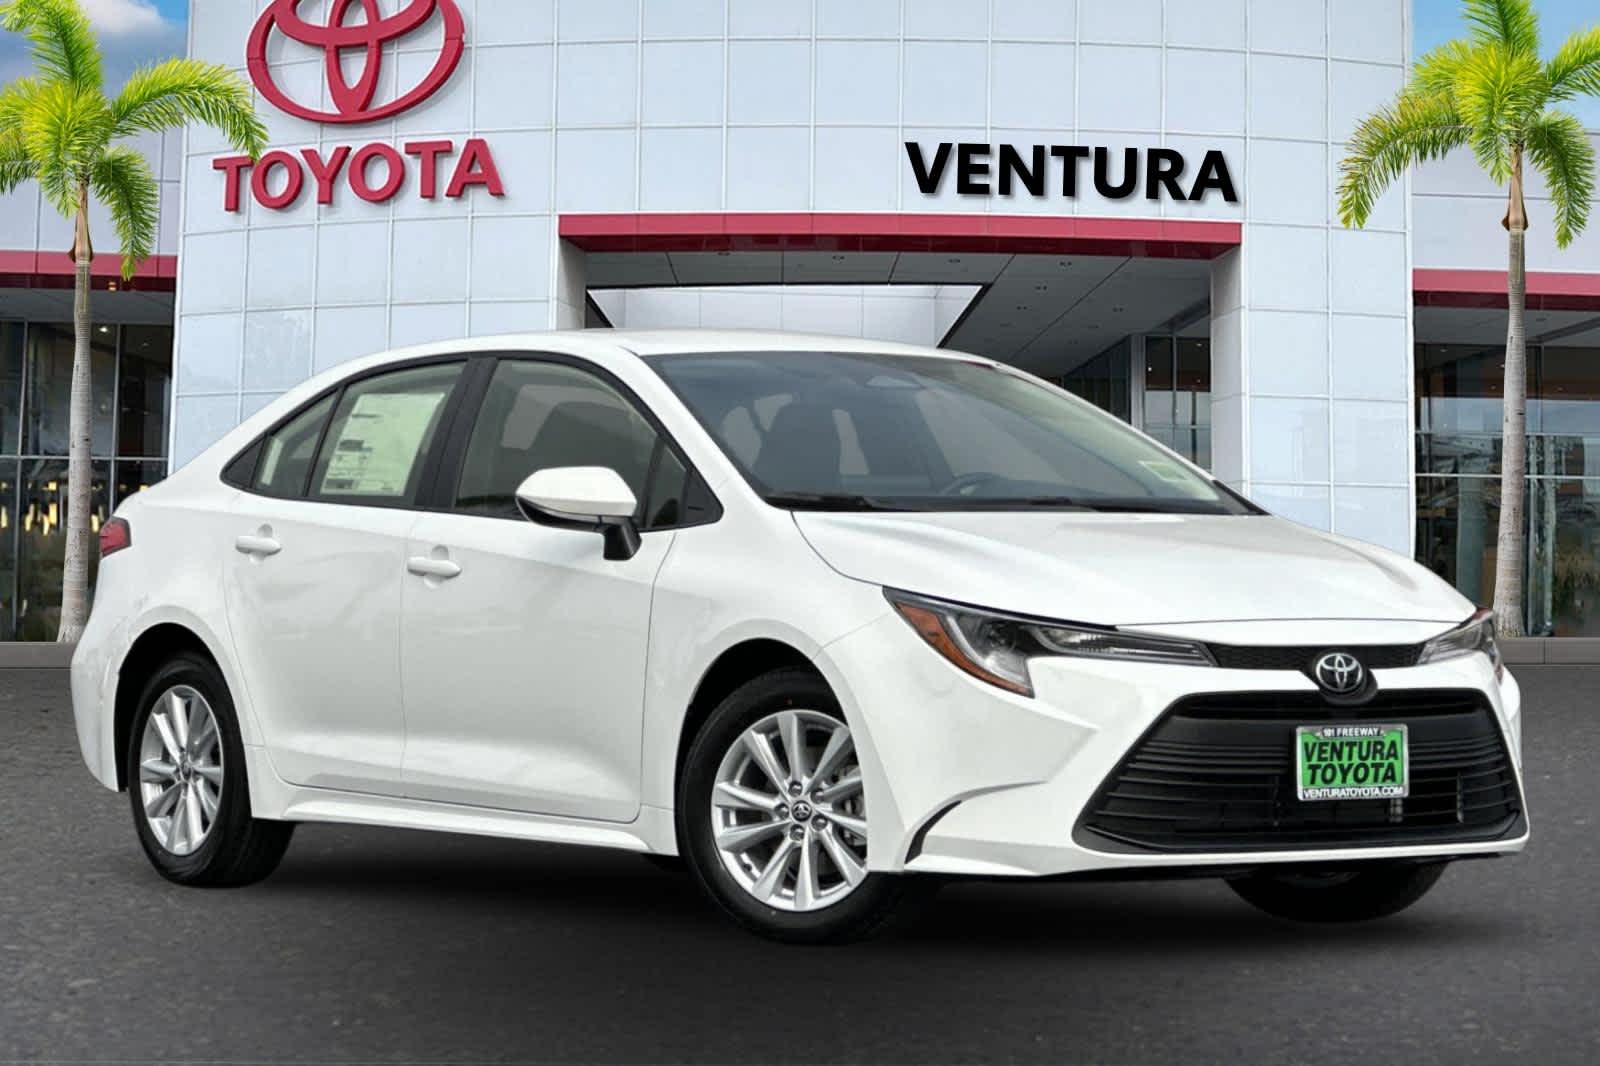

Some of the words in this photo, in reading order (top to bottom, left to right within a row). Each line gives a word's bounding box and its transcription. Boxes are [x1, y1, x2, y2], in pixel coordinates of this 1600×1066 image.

[212, 138, 505, 212] TOYOTA
[904, 141, 1239, 203] VENTURA
[1337, 727, 1378, 737] FREEWAY
[1304, 740, 1399, 762] VENTURA
[1308, 762, 1396, 785] TOYOTA
